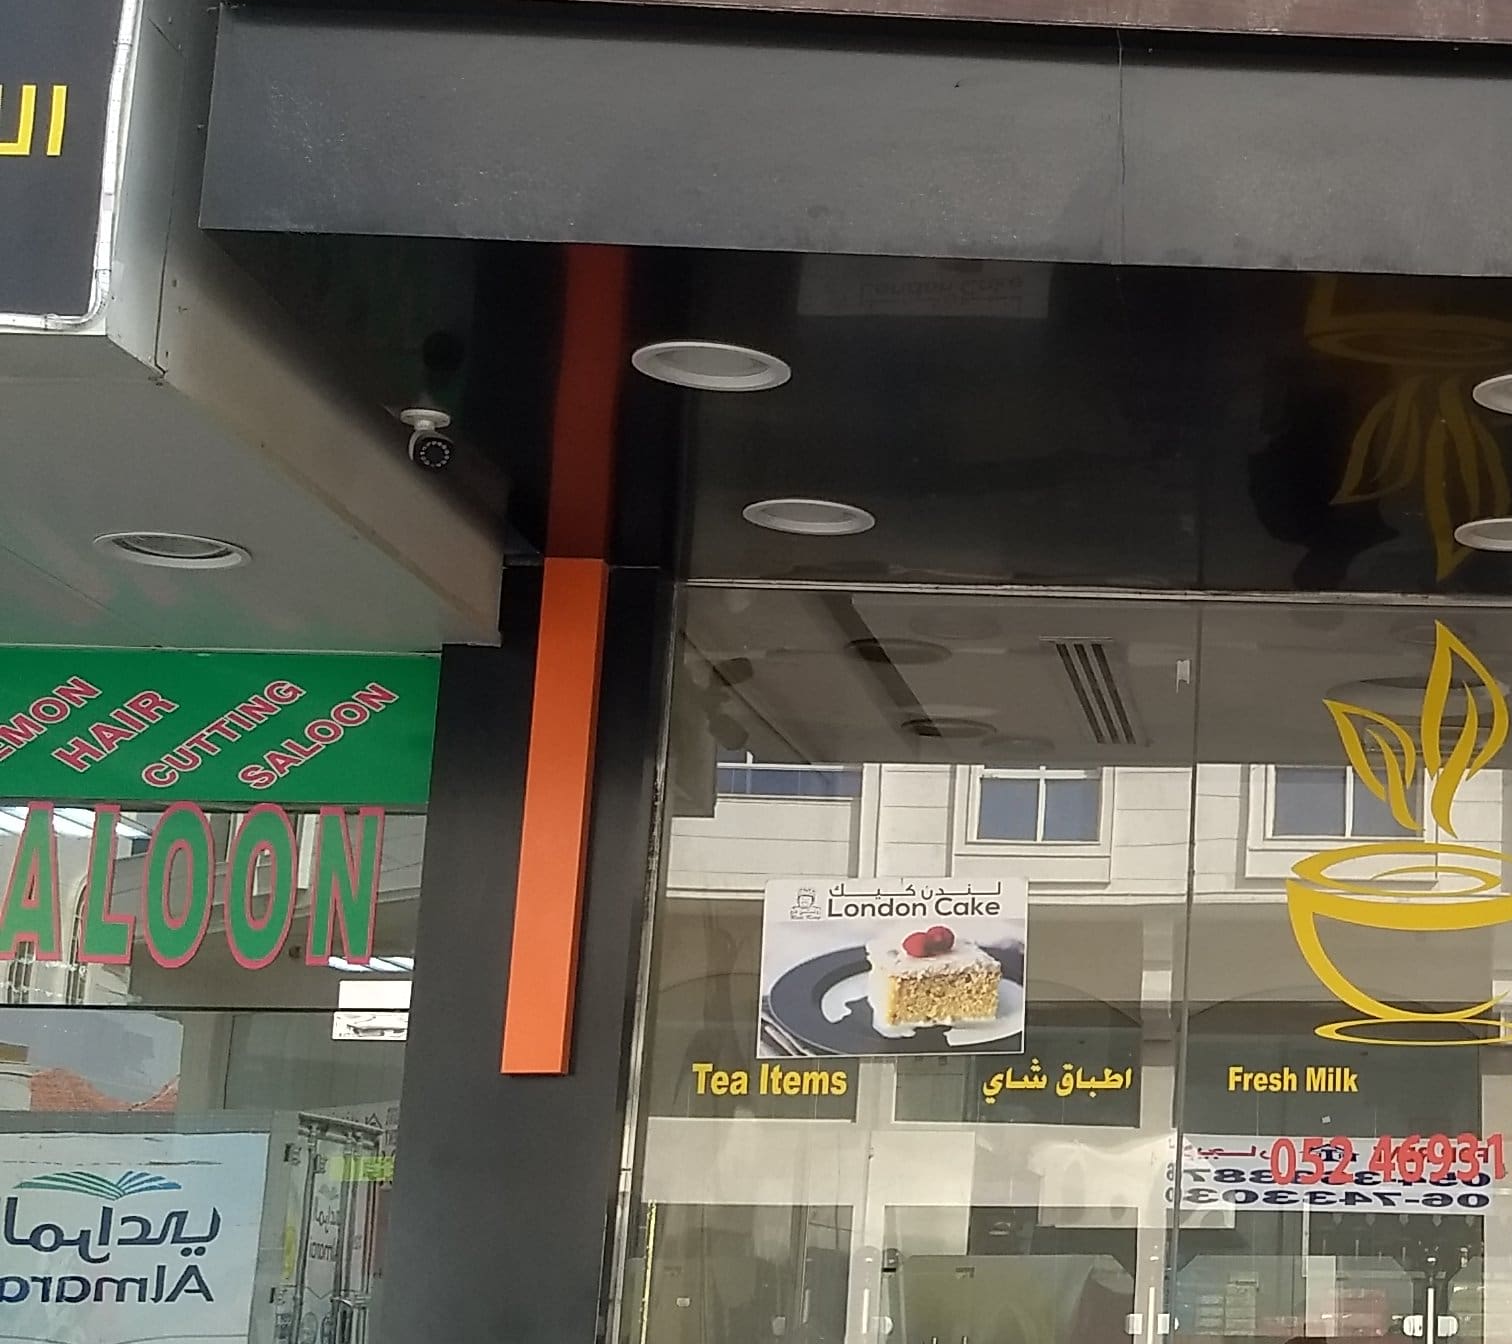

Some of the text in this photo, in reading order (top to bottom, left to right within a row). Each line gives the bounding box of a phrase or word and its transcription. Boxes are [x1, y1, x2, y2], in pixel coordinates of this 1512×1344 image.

[52, 689, 180, 773] HAIR
[140, 679, 308, 789] CUTTING
[236, 681, 400, 791] SALOON
[0, 801, 386, 970] ALOON
[827, 898, 927, 918] London
[934, 897, 1001, 917] Cake
[691, 1063, 848, 1096] Tea Items
[982, 1058, 1134, 1105] اطباق شاي
[1228, 1065, 1359, 1093] Fresh Milk
[1269, 1135, 1354, 1185] 052
